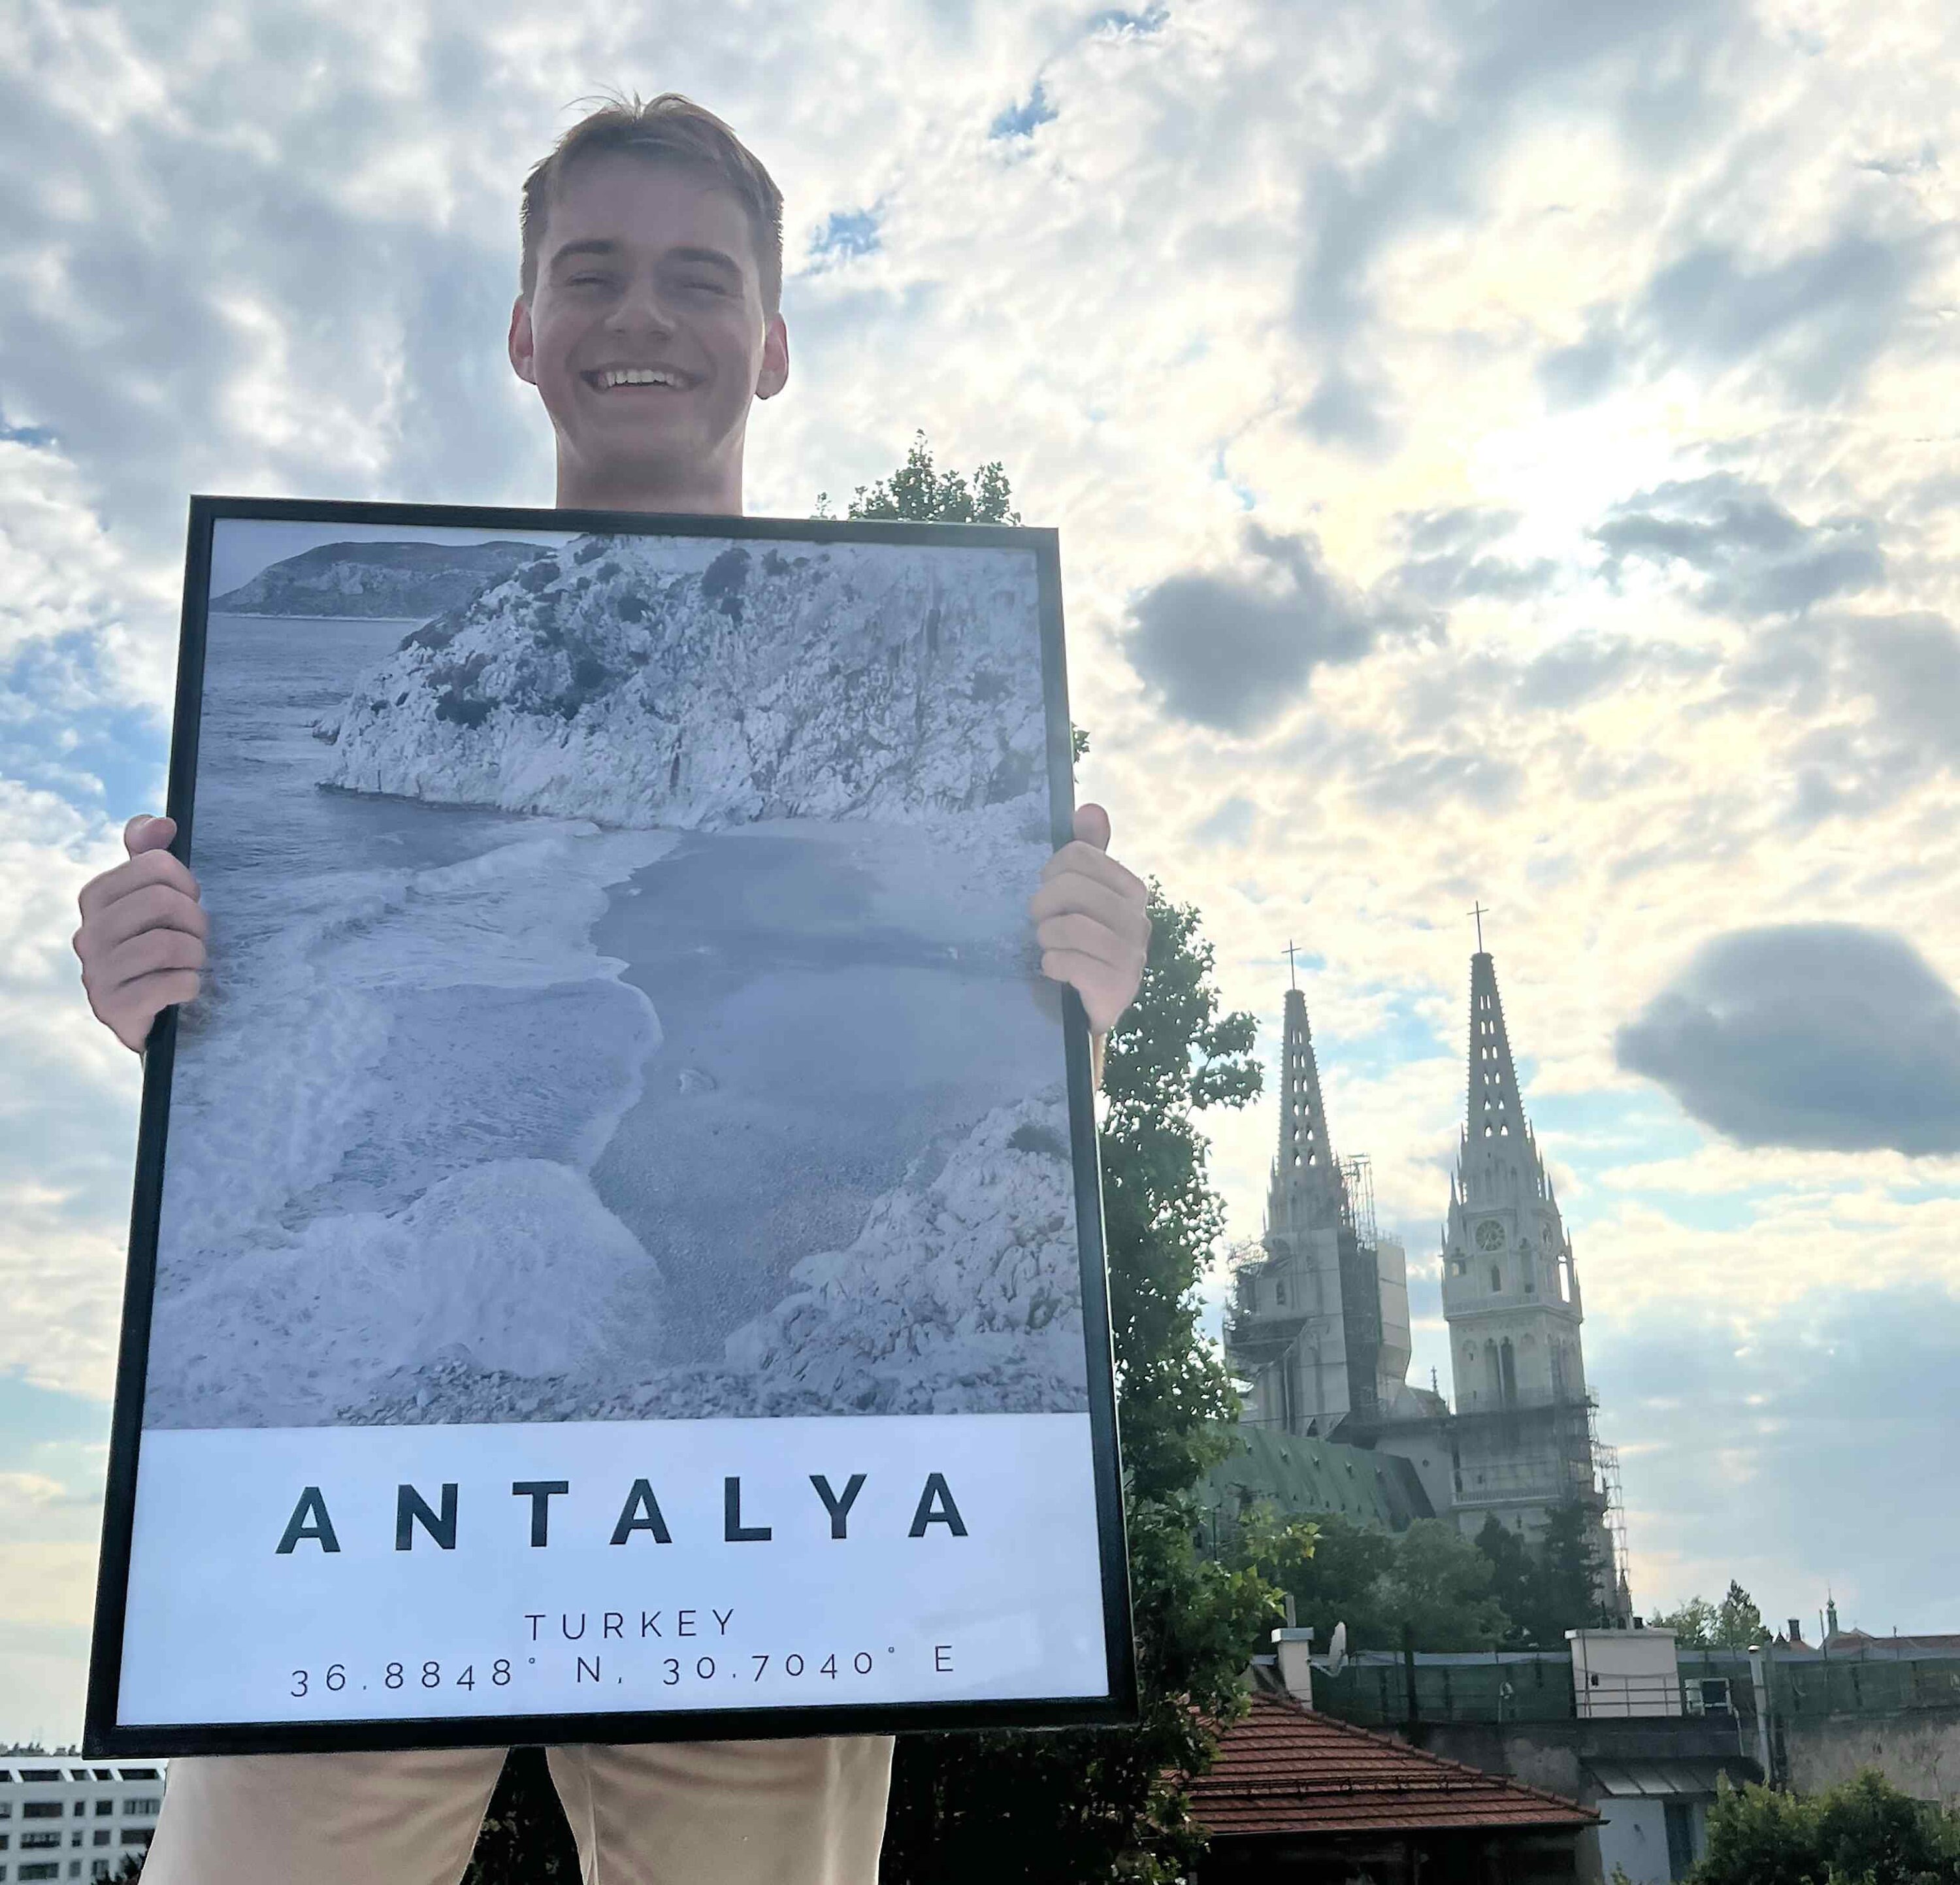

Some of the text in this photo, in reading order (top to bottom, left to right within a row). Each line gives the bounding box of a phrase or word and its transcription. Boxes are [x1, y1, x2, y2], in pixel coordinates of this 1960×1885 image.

[274, 1472, 969, 1554] ANTALYA
[524, 1608, 734, 1641] TURKEY
[290, 1645, 954, 1697] 36.8848° N, 30.7040° E
